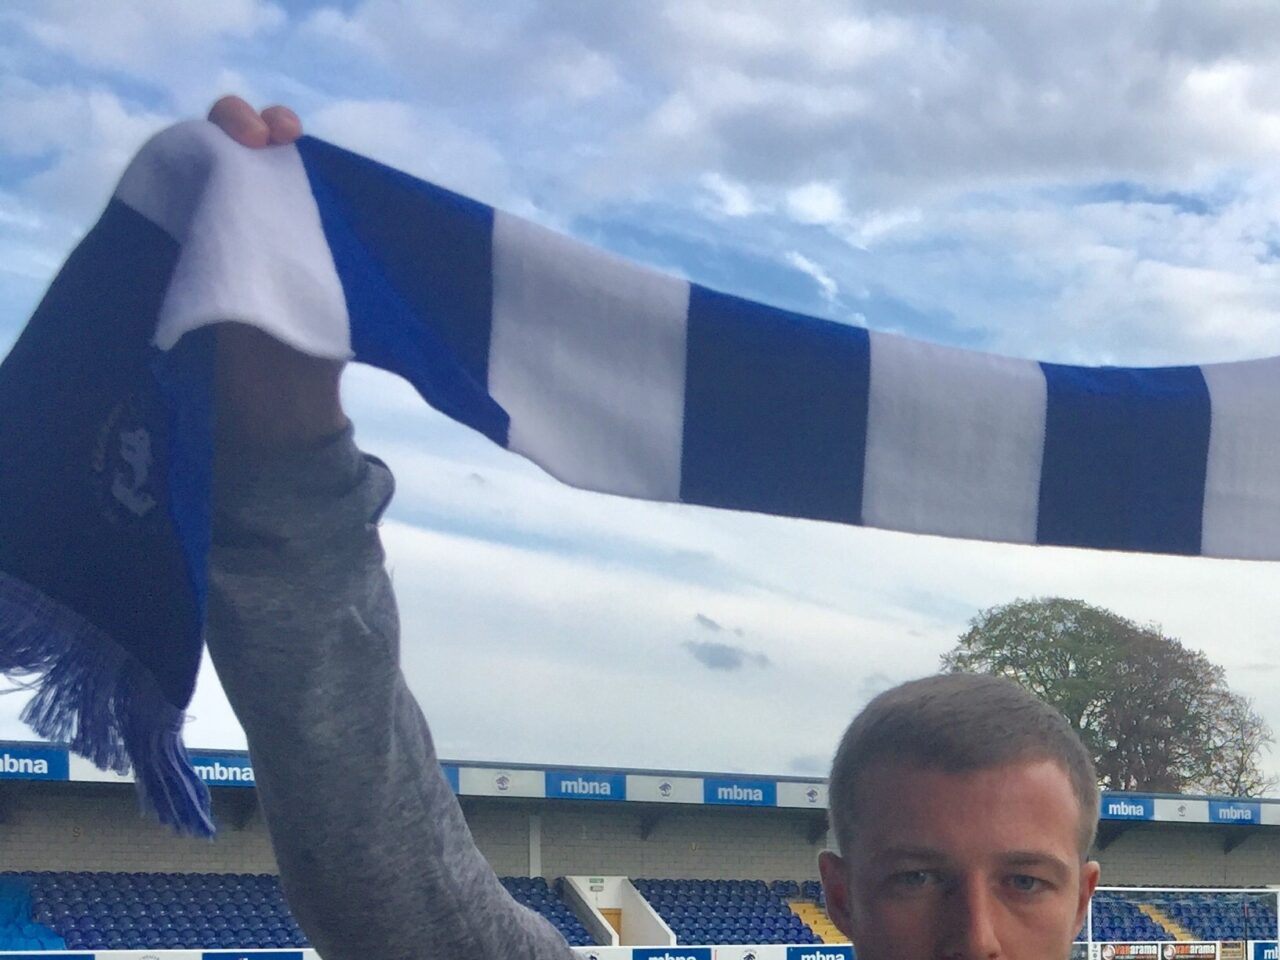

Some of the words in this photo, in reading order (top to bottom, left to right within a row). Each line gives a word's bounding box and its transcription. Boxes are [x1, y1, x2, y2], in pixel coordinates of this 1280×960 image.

[0, 754, 48, 773] bna
[194, 762, 255, 781] mbna
[561, 778, 611, 796] mbna
[718, 785, 763, 801] mbna
[1108, 801, 1144, 816] mbna
[1219, 805, 1252, 820] mbna
